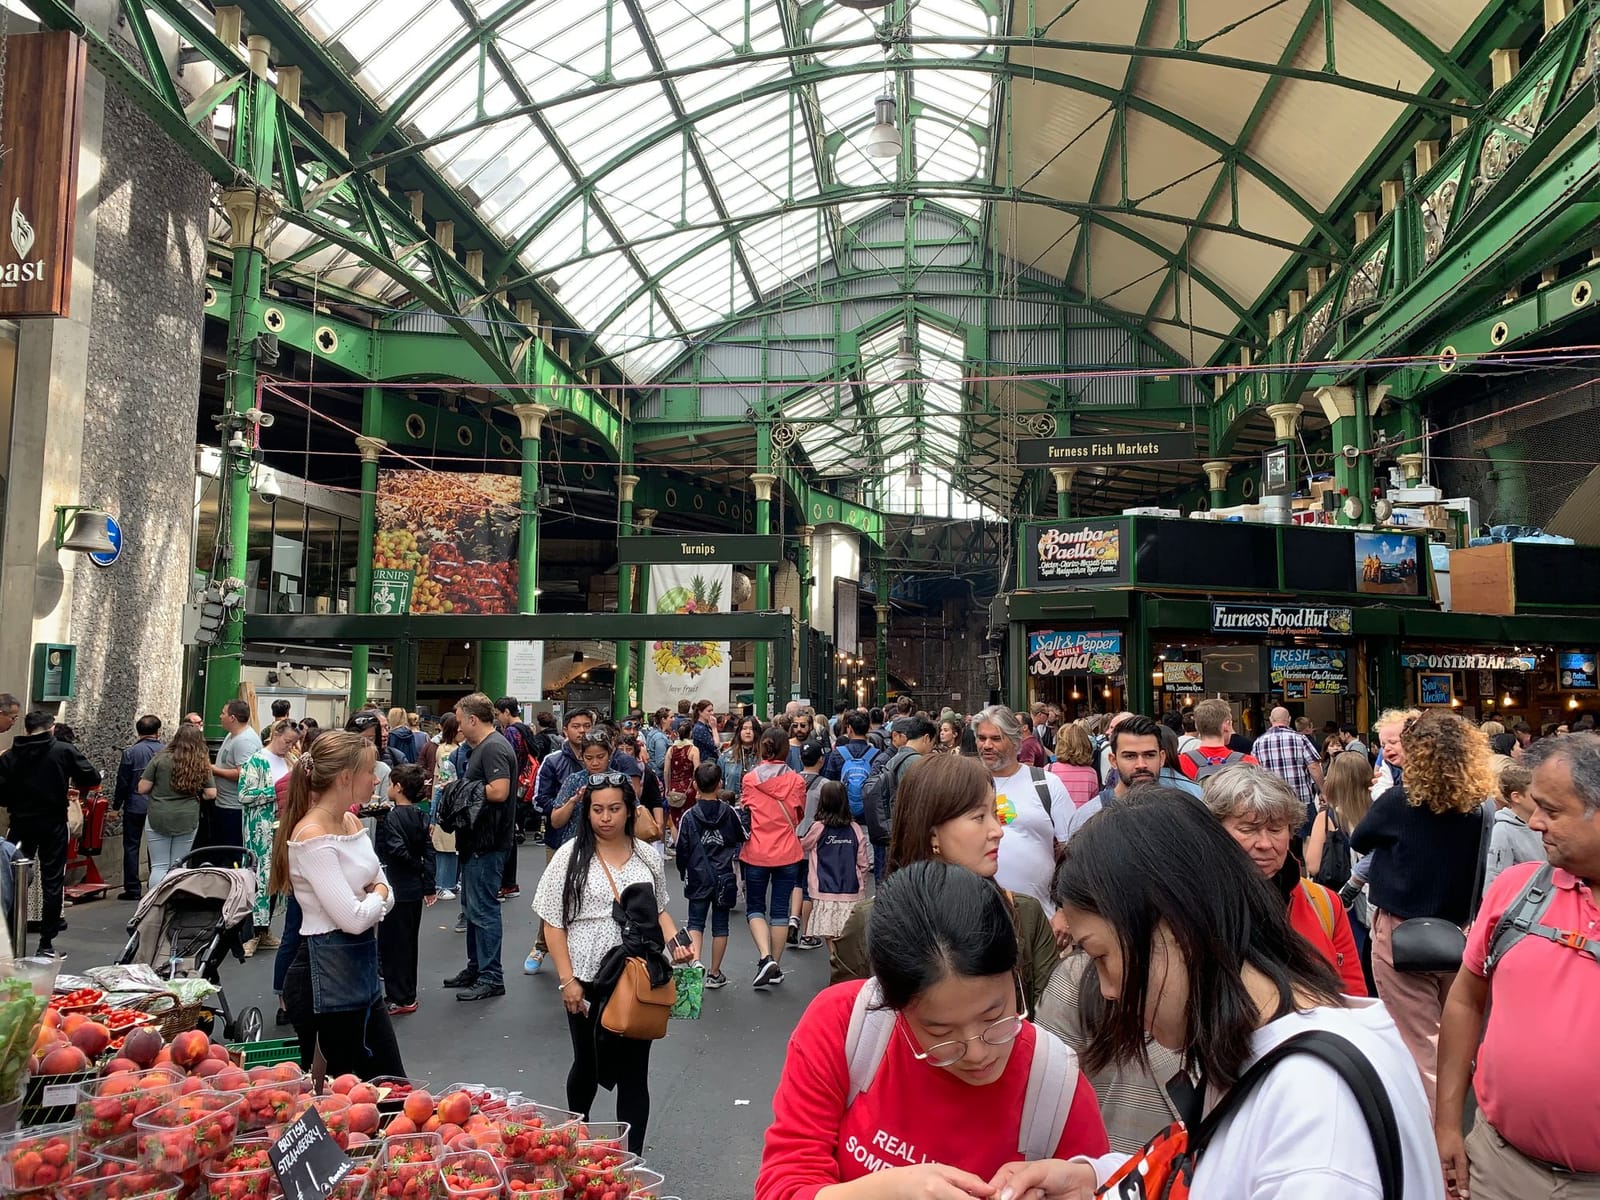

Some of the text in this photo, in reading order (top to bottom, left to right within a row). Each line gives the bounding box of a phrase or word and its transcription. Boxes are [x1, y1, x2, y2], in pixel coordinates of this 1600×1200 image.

[0, 259, 46, 282] ast
[1048, 442, 1159, 458] Furness Fish Markets
[1047, 527, 1103, 544] Bomba
[681, 542, 716, 556] Turnips
[1047, 543, 1096, 560] Paella
[373, 569, 410, 581] URNIPS
[1214, 606, 1329, 628] Furness Food Hut
[1036, 634, 1117, 653] Salt & Pepper
[1056, 646, 1080, 657] CHILLI
[1030, 650, 1091, 676] Squid
[1273, 649, 1310, 662] FRESH
[1427, 654, 1476, 669] OYSTER
[1422, 678, 1437, 691] Sea
[1422, 690, 1447, 704] Urchin
[277, 1119, 308, 1153] BRITISH
[872, 1129, 916, 1164] REAL
